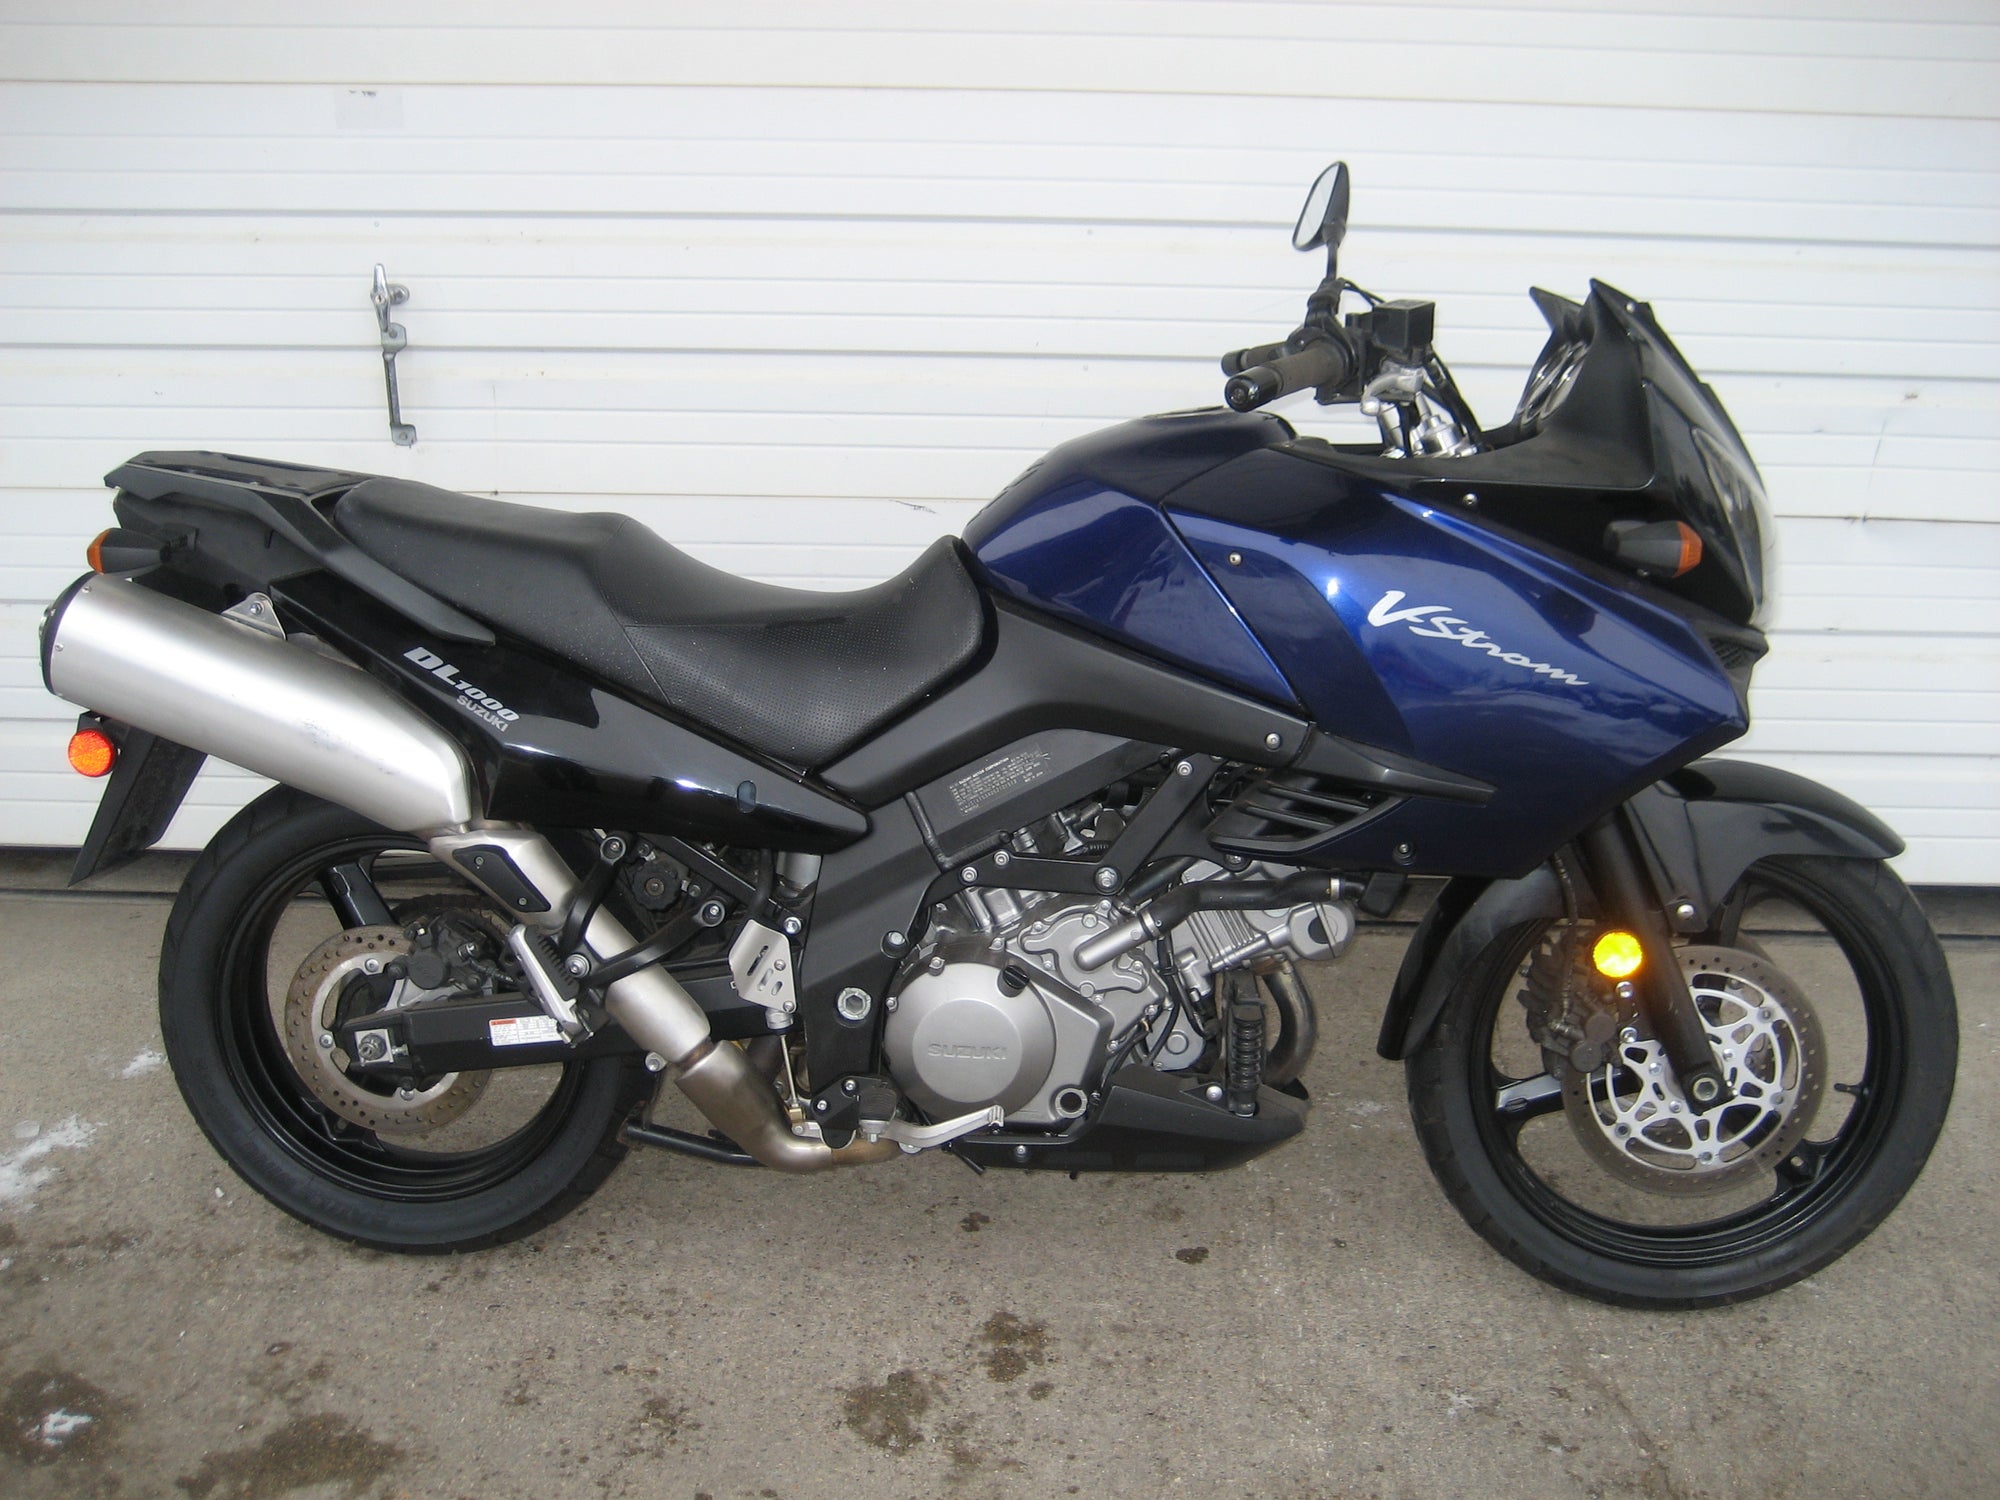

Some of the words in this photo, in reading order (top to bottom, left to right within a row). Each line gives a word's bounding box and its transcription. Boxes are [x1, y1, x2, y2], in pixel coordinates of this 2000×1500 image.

[403, 646, 520, 722] DL1000
[456, 694, 509, 732] SUZUKI
[927, 1043, 1008, 1060] SUZUKI
